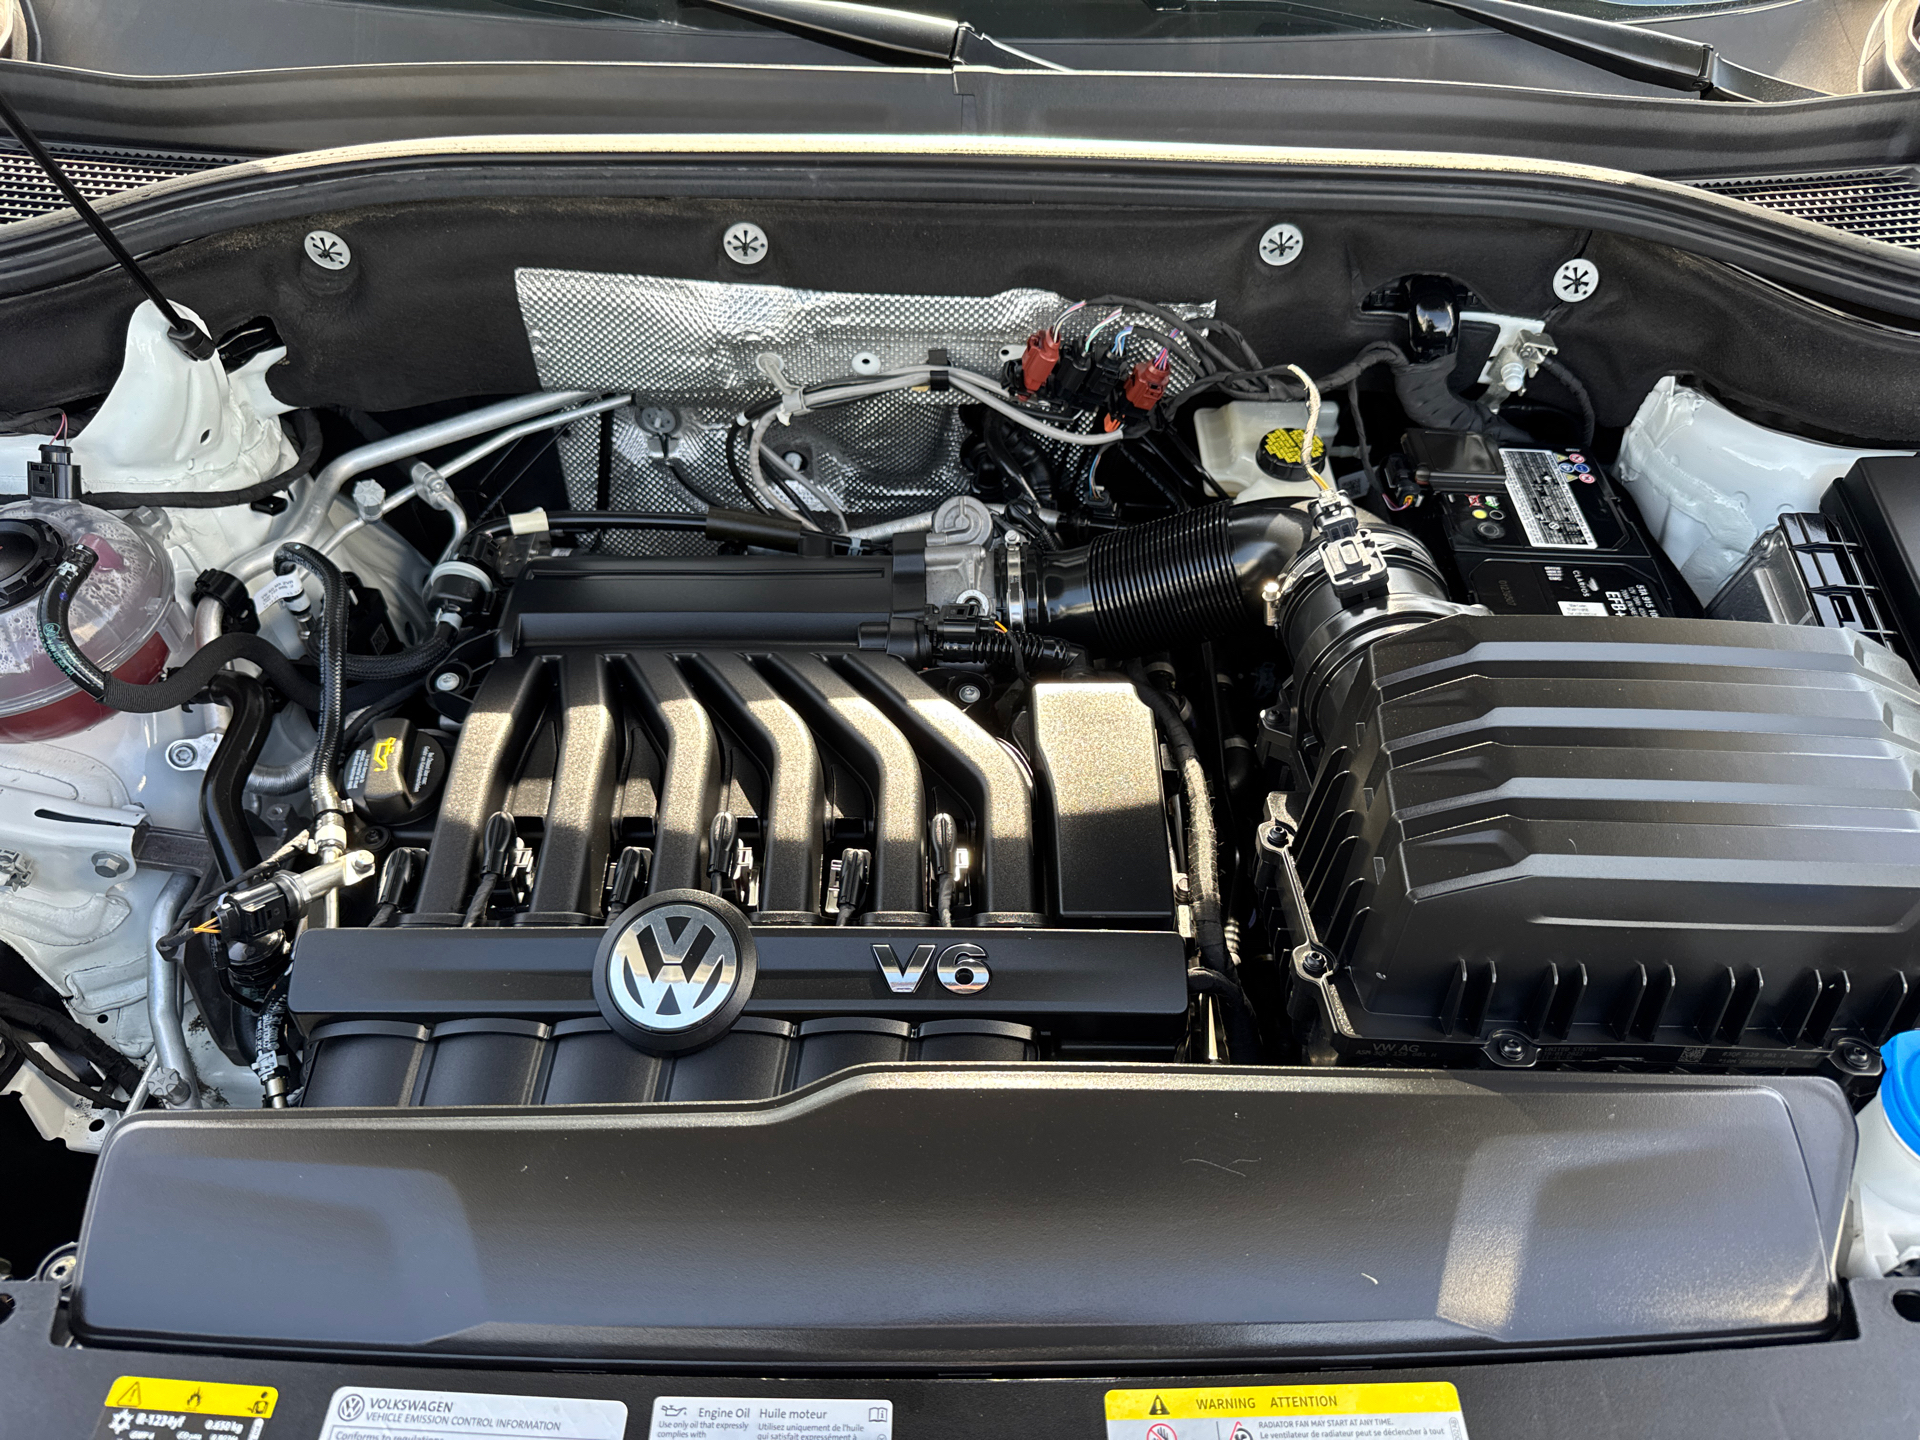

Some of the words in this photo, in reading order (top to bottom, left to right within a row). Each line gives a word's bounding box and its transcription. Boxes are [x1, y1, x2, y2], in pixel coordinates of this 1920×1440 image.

[1605, 591, 1627, 617] EFB+
[871, 943, 990, 996] V6
[1372, 1043, 1396, 1051] VW
[1398, 1044, 1420, 1053] AG
[370, 1398, 453, 1412] VOLKSWAGEN
[1195, 1397, 1256, 1410] WARNING
[1270, 1395, 1338, 1408] ATTENTION
[698, 1407, 733, 1420] Engine
[735, 1408, 750, 1418] Oil
[759, 1408, 786, 1419] Huile
[789, 1410, 828, 1419] moteur
[366, 1412, 403, 1422] VEHICLE
[404, 1413, 449, 1425] EMISSION
[451, 1415, 493, 1428] CONTROL
[495, 1418, 561, 1431] INFORMATION
[673, 1421, 689, 1430] only
[690, 1421, 698, 1429] oil
[699, 1421, 714, 1429] that
[715, 1421, 749, 1431] expressly
[1258, 1420, 1294, 1429] RADIATOR
[1295, 1420, 1309, 1428] FAN
[1327, 1419, 1348, 1427] START
[1349, 1419, 1359, 1427] AT
[1375, 1418, 1394, 1426] TIME.
[758, 1423, 785, 1431] Utilisez
[786, 1423, 830, 1433] uniquement
[832, 1423, 841, 1431] de
[842, 1424, 864, 1432] l'huile
[1260, 1432, 1268, 1440] Le
[1270, 1430, 1309, 1439] ventilateur
[1310, 1430, 1320, 1438] de
[1321, 1430, 1354, 1438] radiateur
[1355, 1430, 1371, 1439] peut
[1383, 1428, 1421, 1437] déclencher
[1429, 1427, 1445, 1435] tout
[335, 1431, 379, 1440] Conforms
[382, 1432, 391, 1440] to
[657, 1430, 689, 1440] complies
[757, 1432, 769, 1440] qui
[770, 1432, 799, 1440] satisfait
